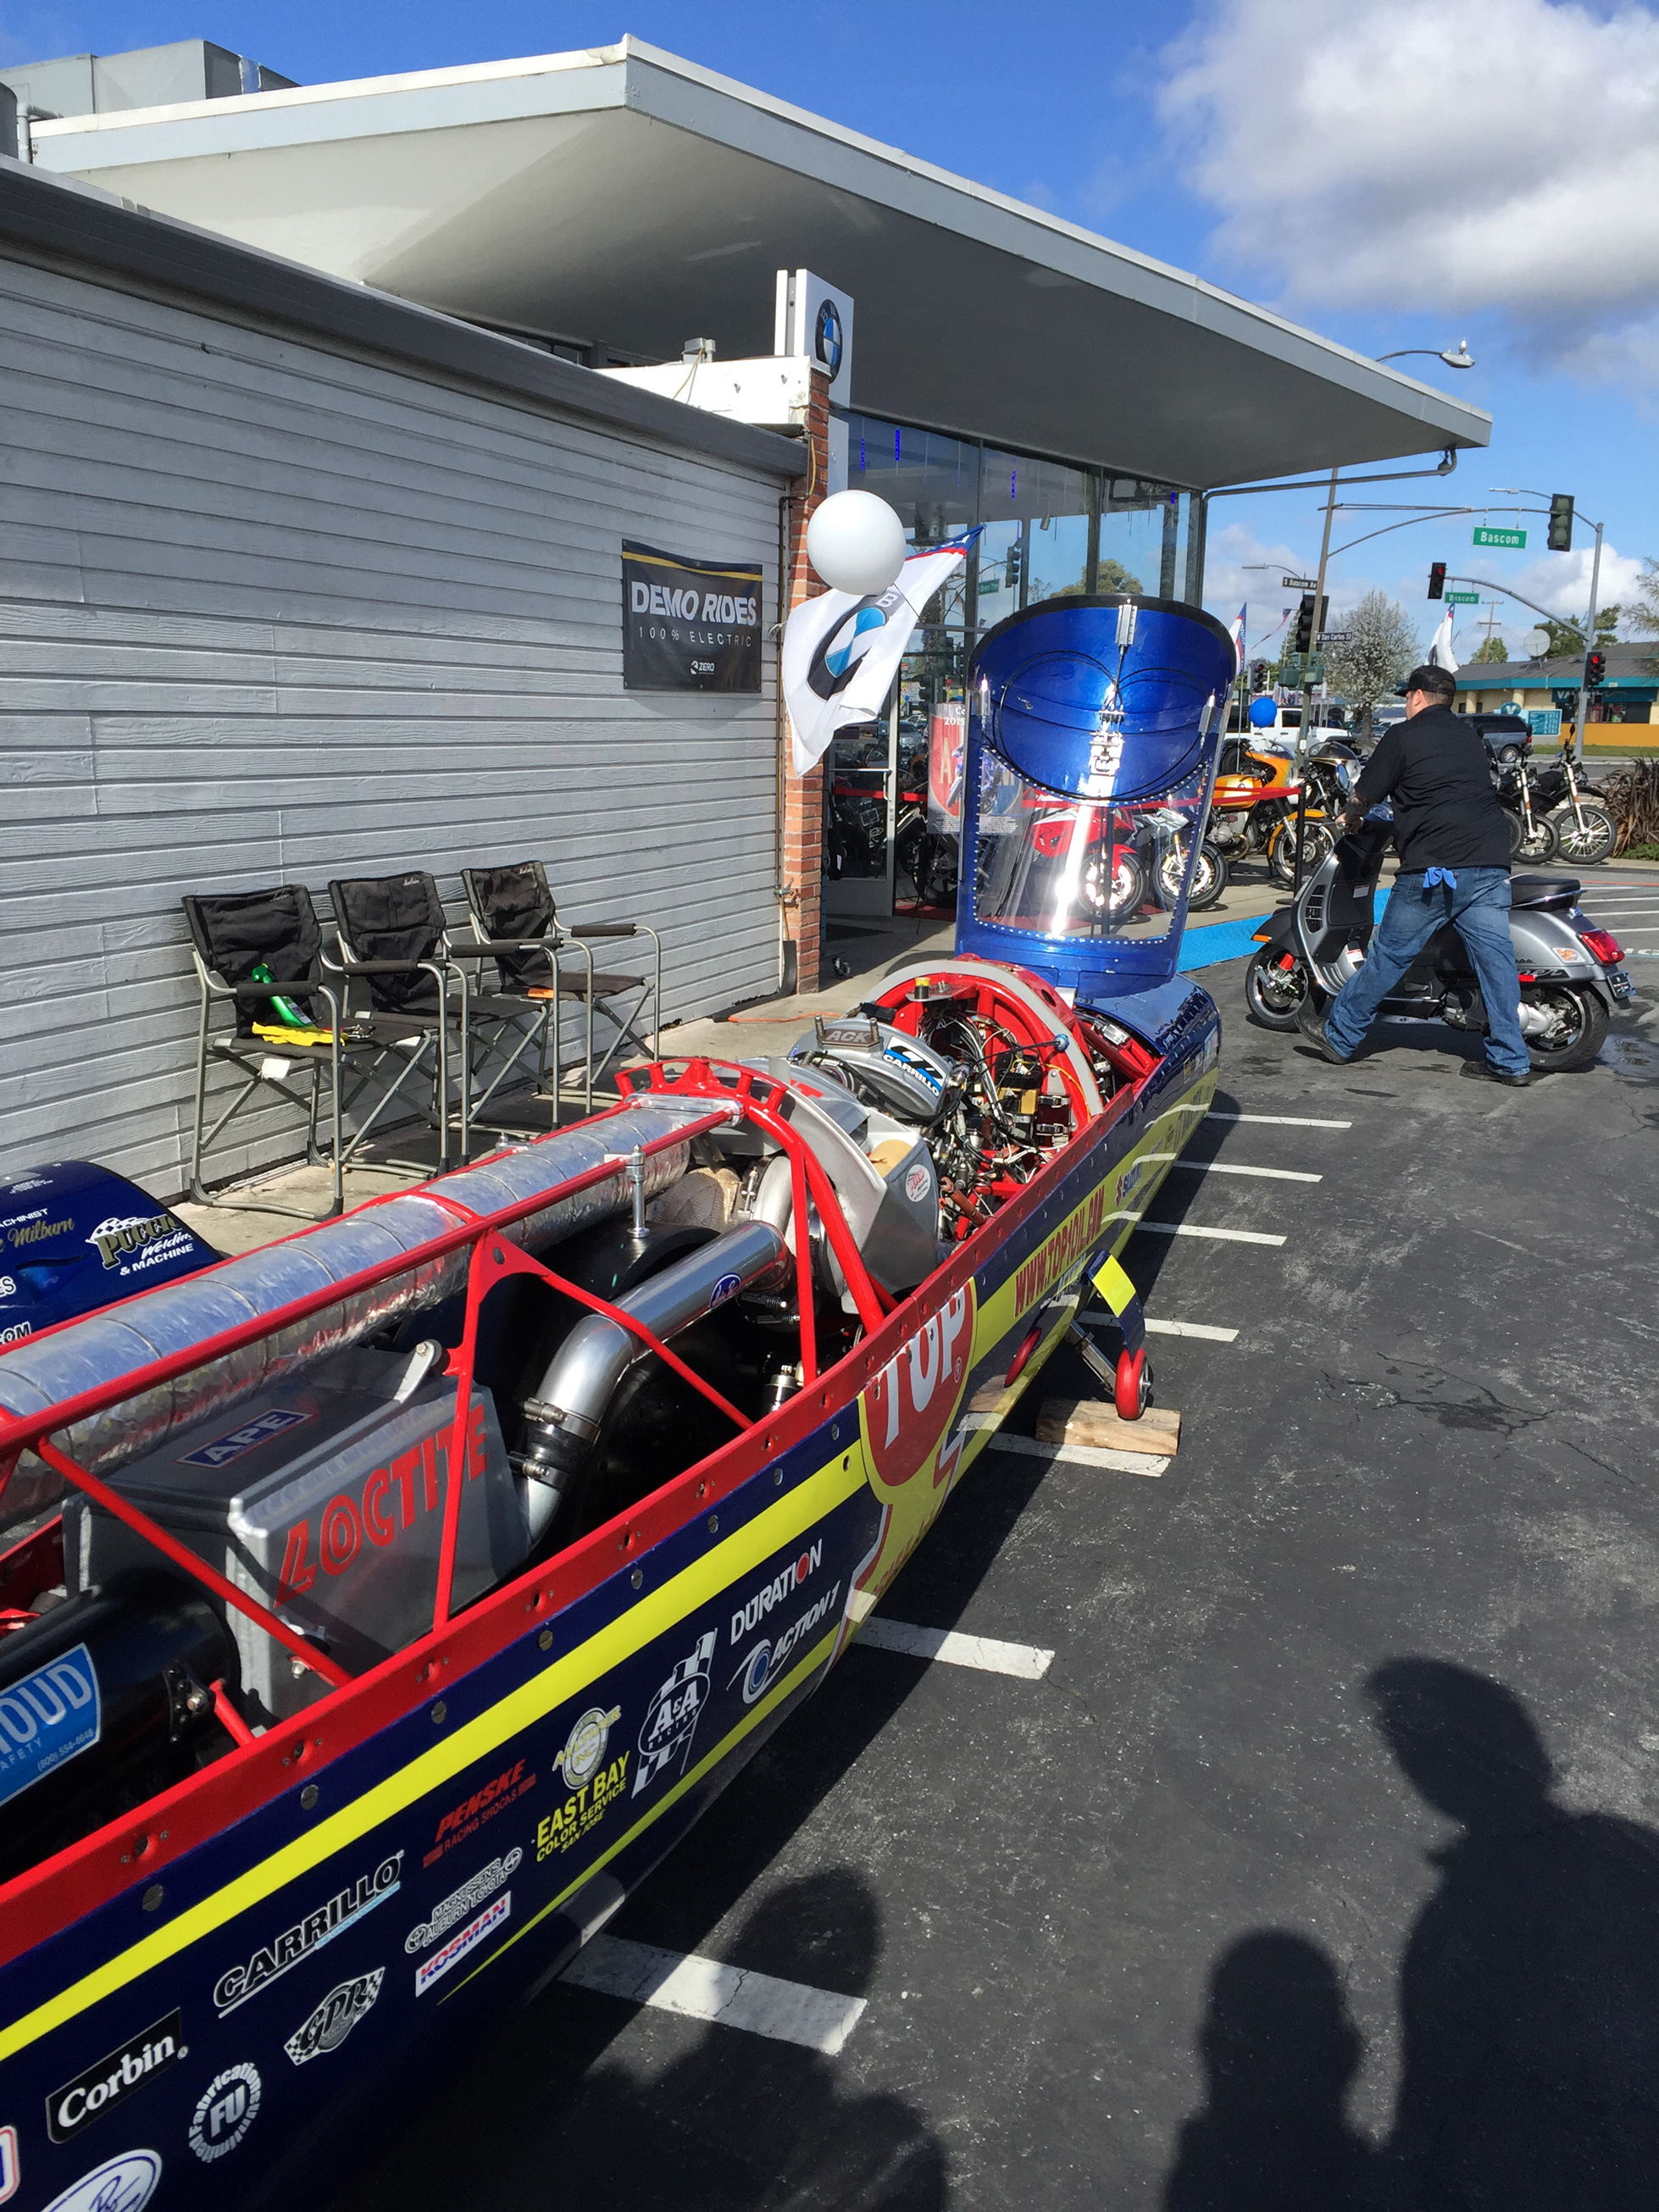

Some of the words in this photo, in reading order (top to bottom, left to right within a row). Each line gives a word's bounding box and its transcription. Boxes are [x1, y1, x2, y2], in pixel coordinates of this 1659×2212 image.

[1480, 531, 1519, 545] Bascom
[631, 582, 699, 621] DEMO
[702, 593, 757, 626] RIDES
[1290, 579, 1308, 588] Bascom
[1449, 594, 1475, 602] Bascom
[639, 626, 680, 640] 100%
[690, 631, 752, 647] ELECTRIC
[698, 662, 715, 671] ZERO
[826, 1031, 871, 1043] ACK
[883, 1054, 940, 1098] CARRILLO
[8, 1217, 75, 1248] Milburn
[119, 1267, 130, 1276] &
[133, 1243, 194, 1272] MACHINE
[877, 1286, 966, 1450] TOP
[204, 1414, 295, 1461] APE
[274, 1404, 487, 1609] LOCTITE
[730, 1538, 823, 1645] DURATION
[647, 1680, 700, 1742] A&A
[649, 1708, 697, 1750] RACING
[0, 1738, 42, 1771] AFETY
[435, 1758, 526, 1843] PENSKE
[444, 1820, 480, 1853] RACING
[482, 1788, 518, 1825] SHOCKS
[536, 1784, 590, 1849] EAST
[593, 1750, 630, 1801] BAY
[536, 1821, 578, 1862] COLOR
[580, 1777, 627, 1827] SERVICE
[560, 1831, 581, 1854] SAN
[582, 1808, 606, 1836] JOSE
[213, 1855, 402, 2009] CARRILLO
[424, 1898, 469, 1947] AUBURN
[470, 1871, 508, 1908] TOYOTA
[420, 1898, 507, 1985] KOSMAN
[58, 2036, 175, 2127] Corbin
[210, 2084, 246, 2138] FU
